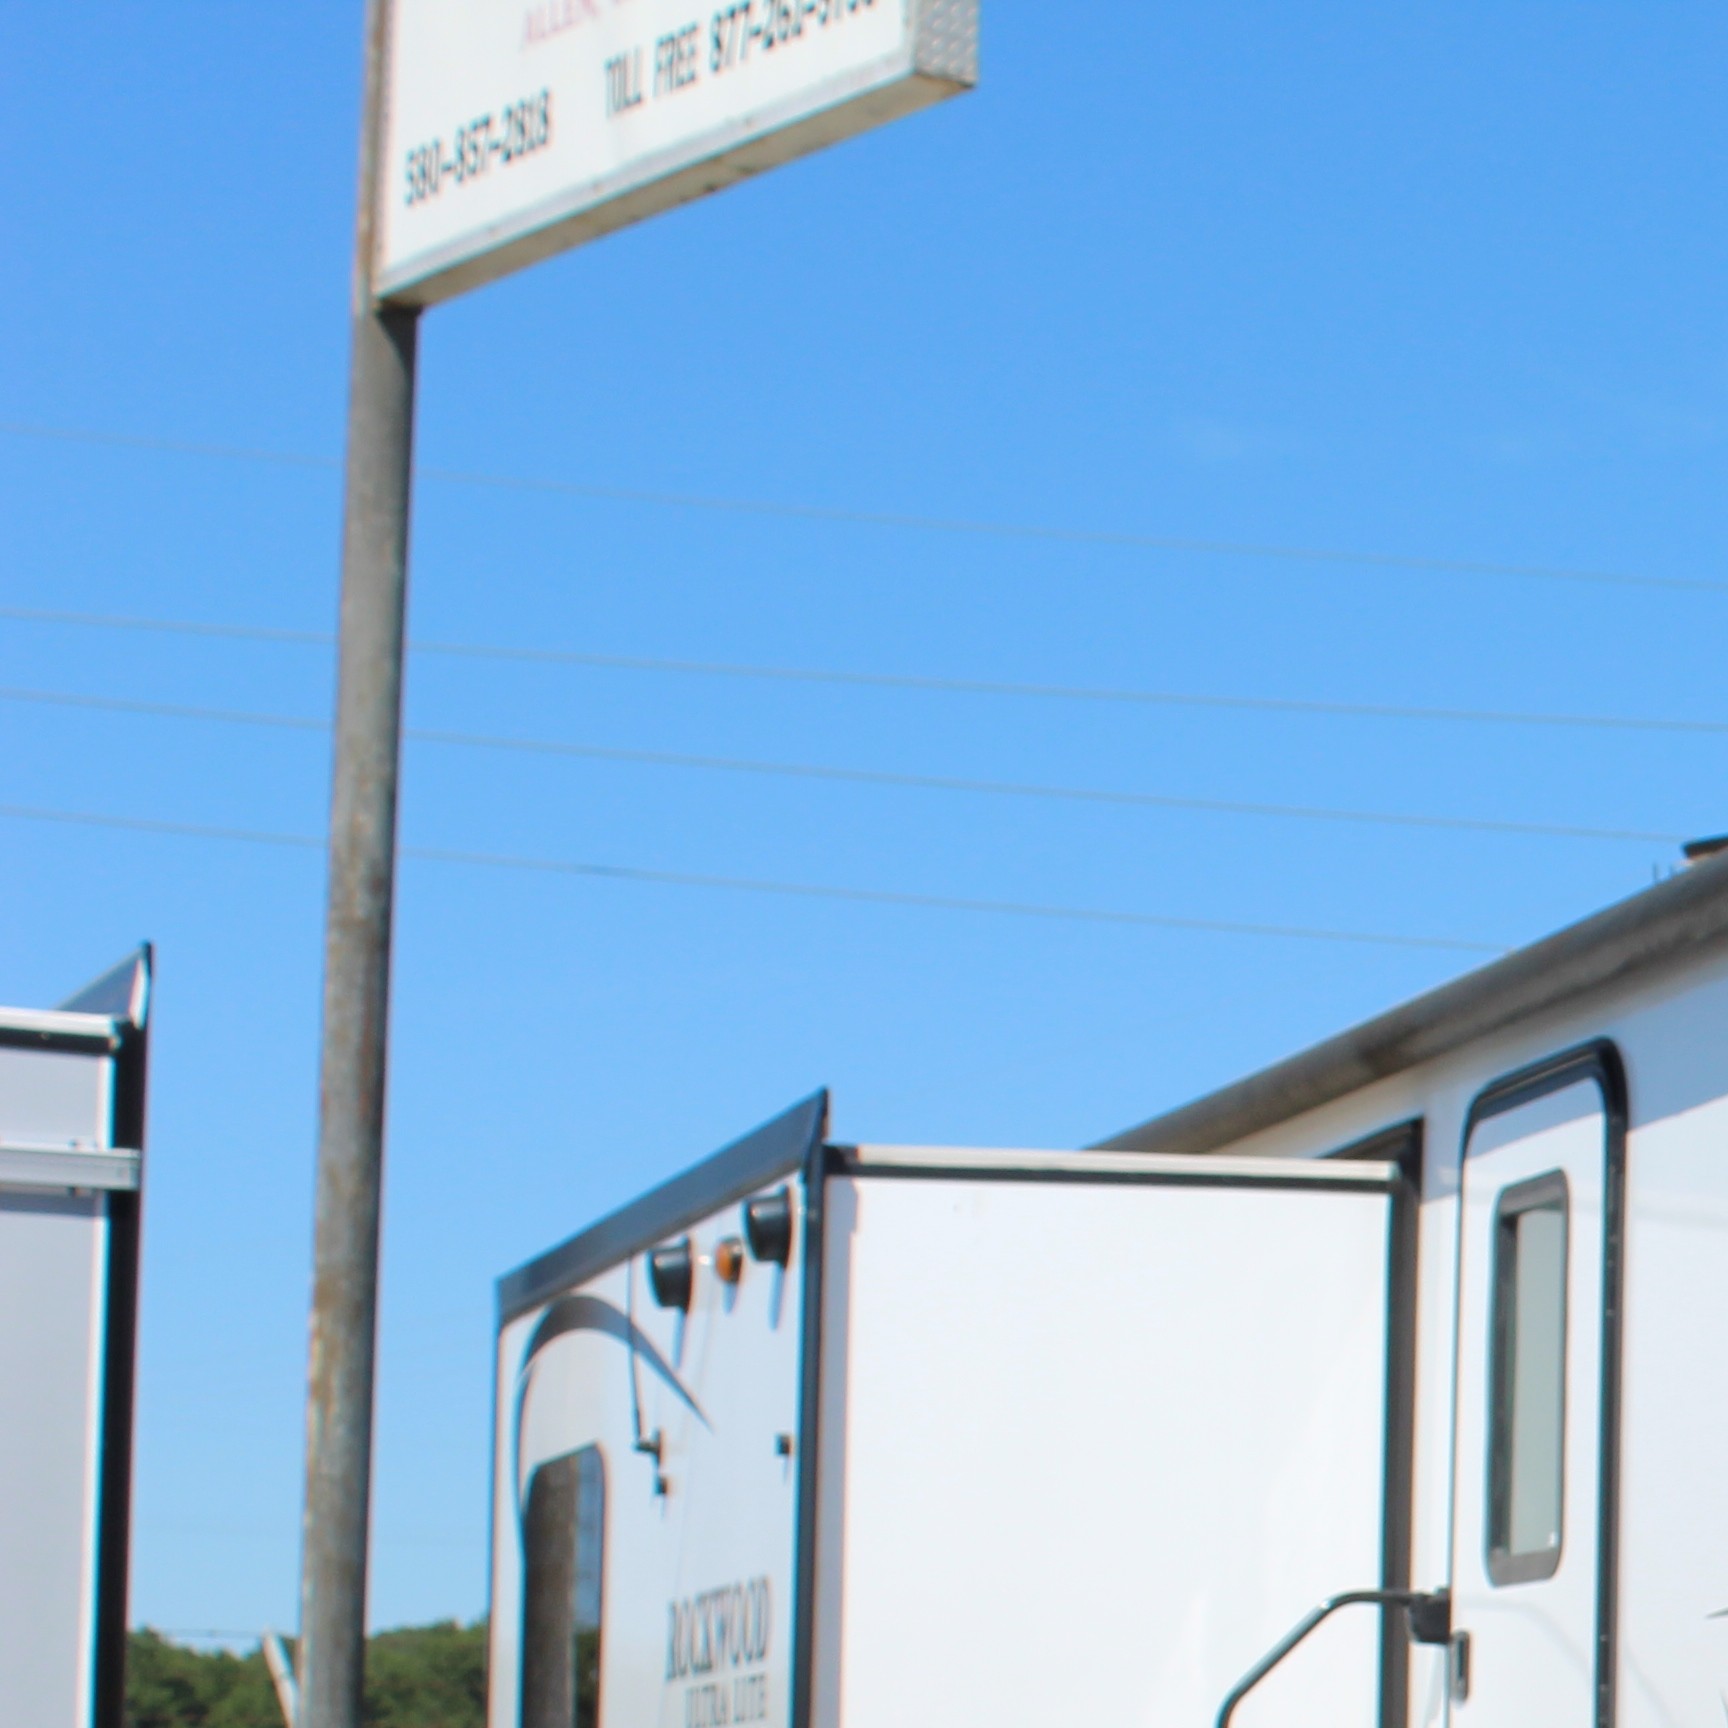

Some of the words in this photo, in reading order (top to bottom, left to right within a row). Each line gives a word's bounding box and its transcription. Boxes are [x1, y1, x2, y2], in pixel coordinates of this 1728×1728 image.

[602, 48, 643, 118] TOLL
[651, 22, 699, 99] FREE
[666, 1576, 773, 1683] ROCKWOOD
[732, 1673, 768, 1723] LITE
